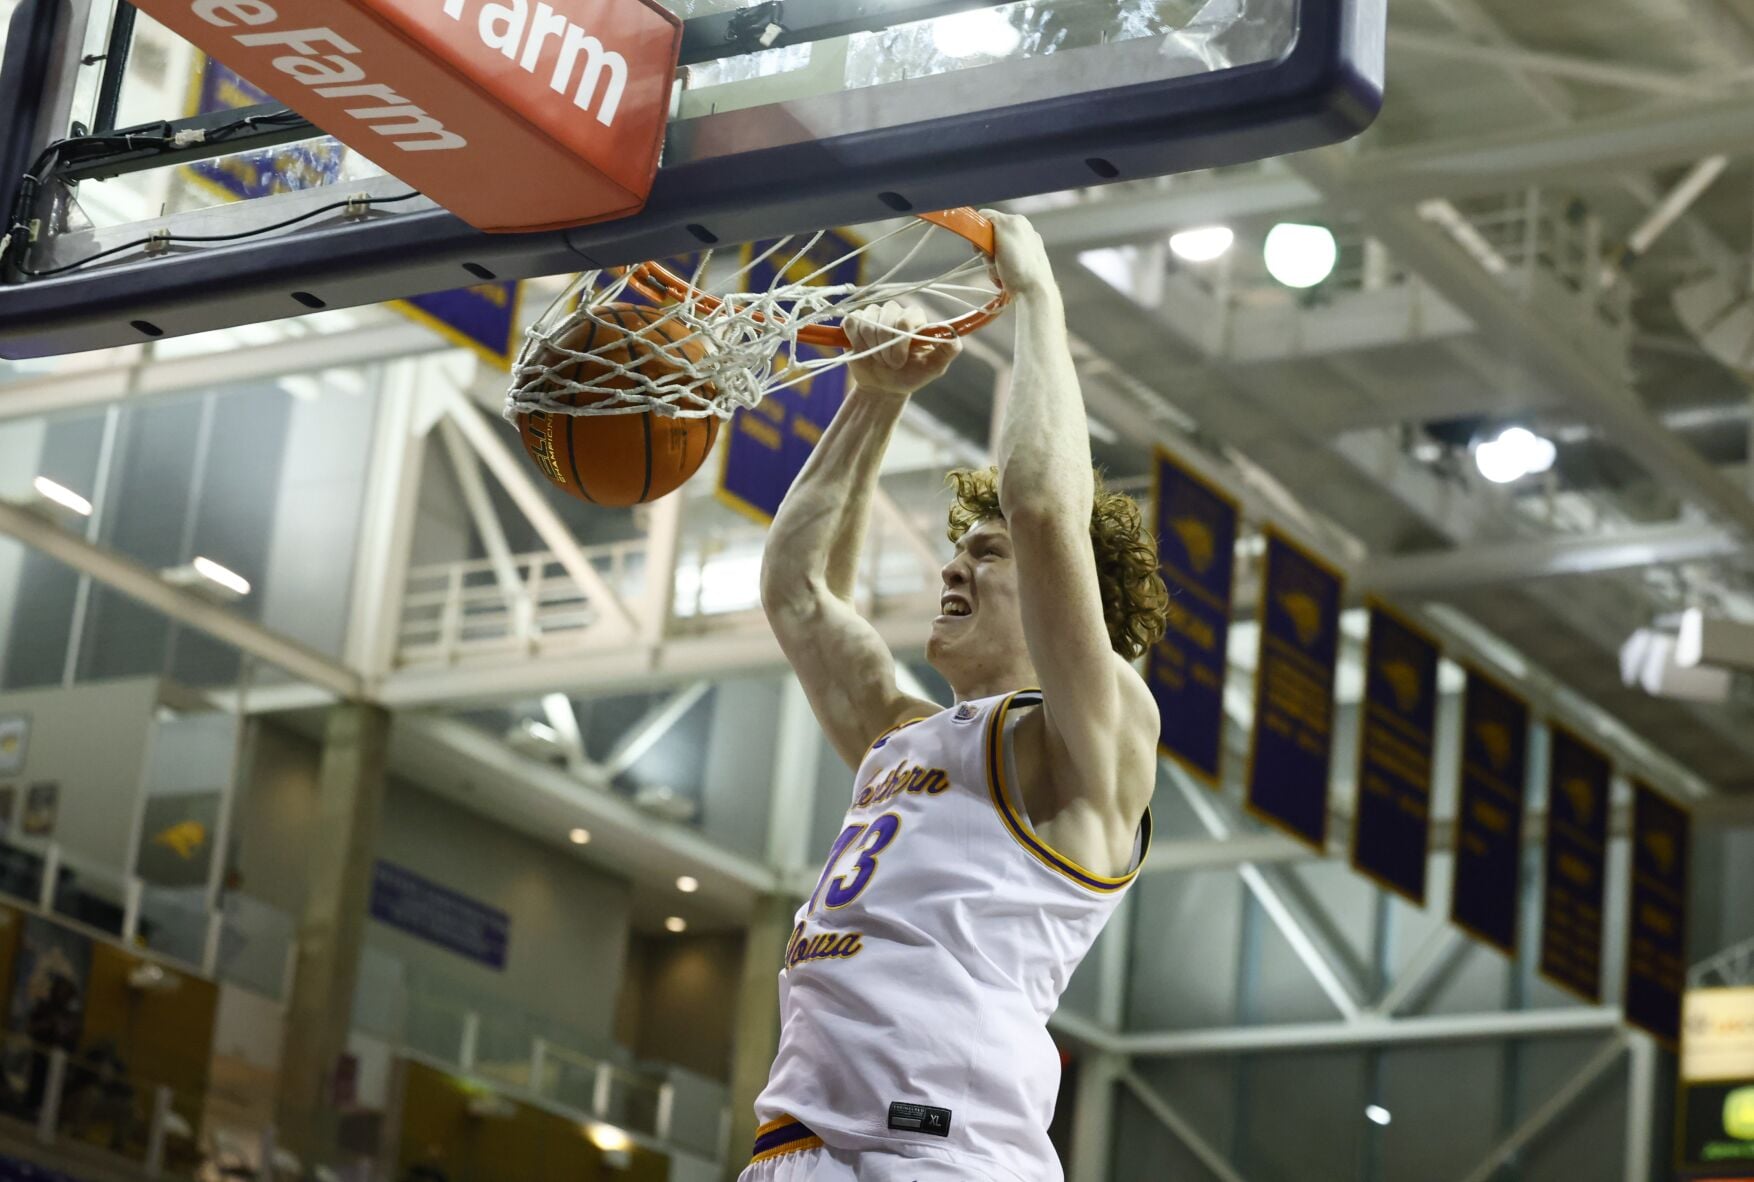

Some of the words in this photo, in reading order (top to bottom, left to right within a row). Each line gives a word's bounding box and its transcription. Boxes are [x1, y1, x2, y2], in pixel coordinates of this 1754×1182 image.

[231, 27, 468, 152] Farm
[443, 0, 628, 127] arm
[929, 1114, 942, 1127] XL
